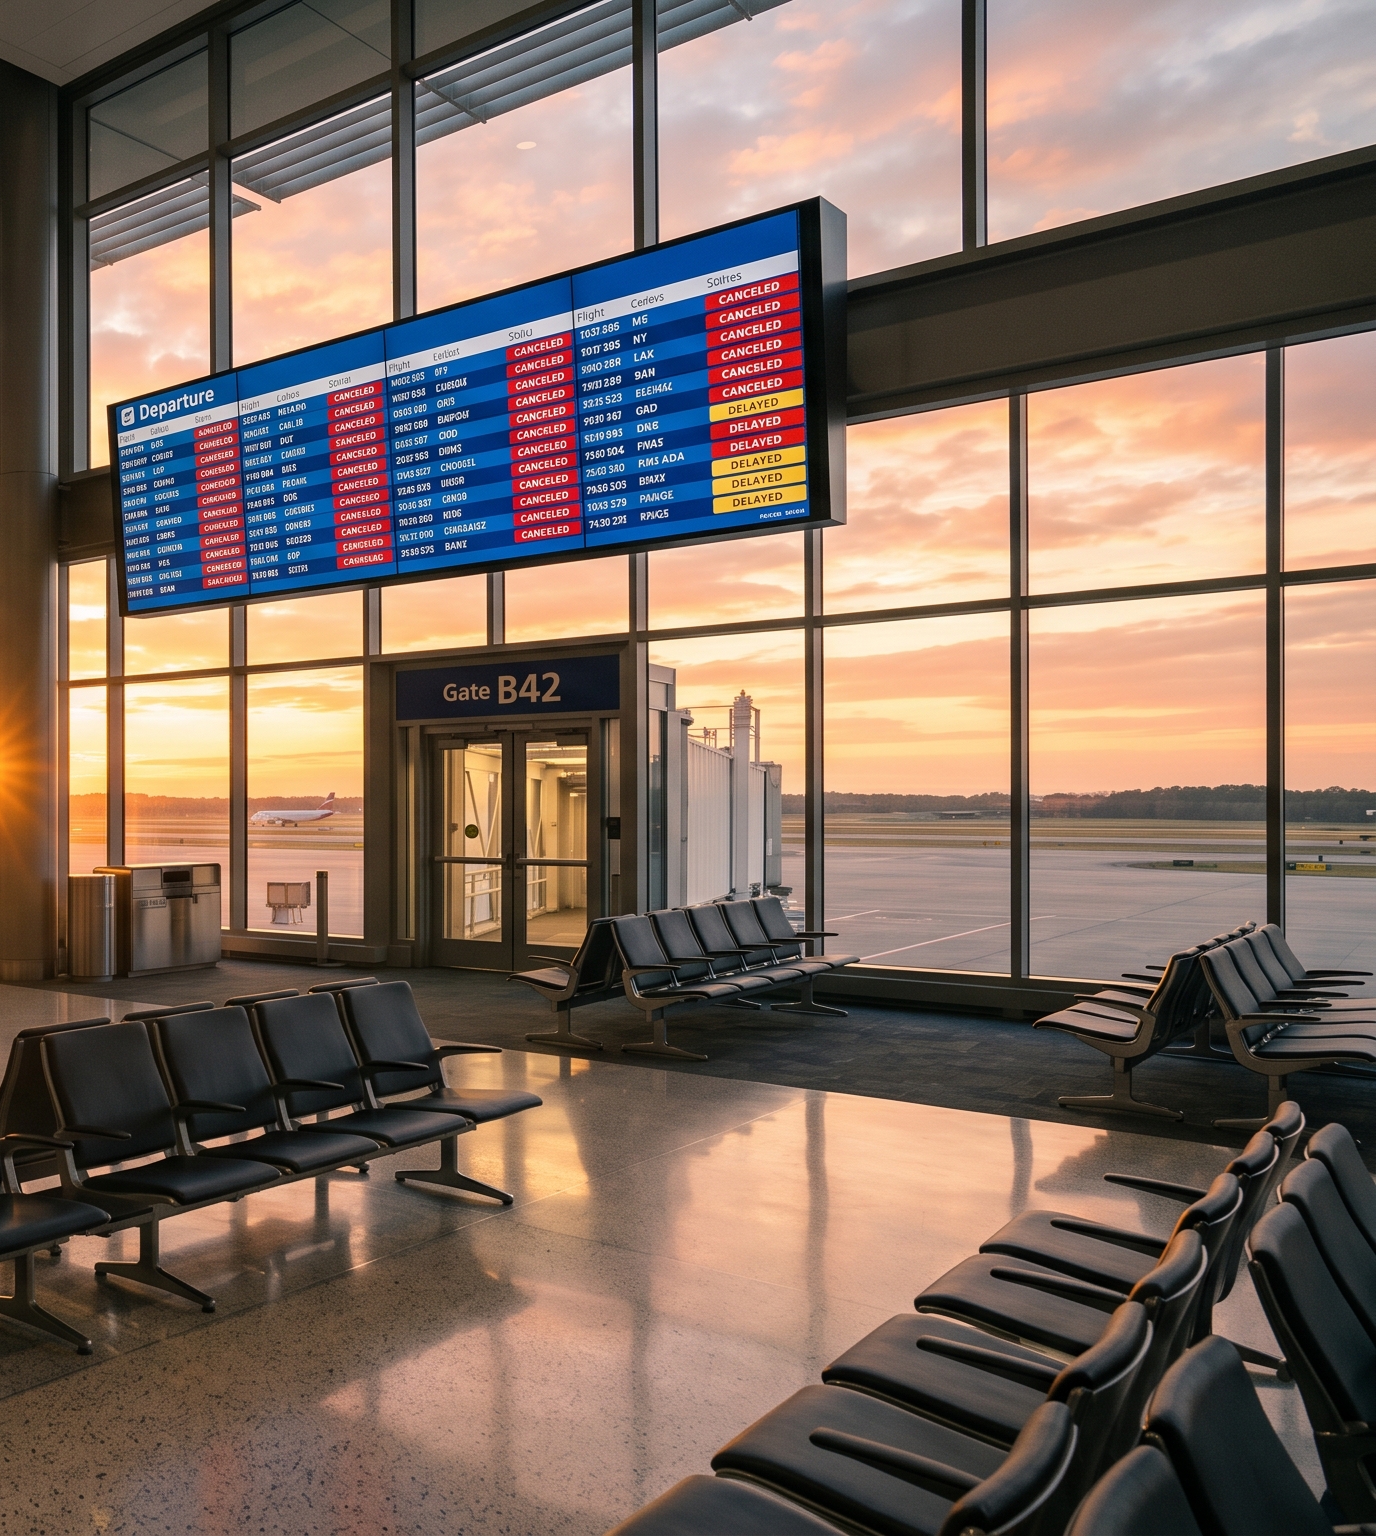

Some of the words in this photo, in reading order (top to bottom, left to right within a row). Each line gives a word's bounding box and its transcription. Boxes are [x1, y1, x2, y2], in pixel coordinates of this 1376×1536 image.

[719, 282, 779, 304] CANCELED
[577, 308, 604, 322] Flight
[633, 332, 647, 344] NY
[719, 301, 780, 323] CANCELED
[720, 320, 781, 341] CANCELED
[514, 338, 563, 356] CANCELED
[721, 340, 782, 360] CANCELED
[516, 372, 564, 390] CANCELED
[723, 378, 782, 397] CANCELED
[334, 386, 374, 401] CANCELED
[516, 389, 565, 407] CANCELED
[140, 389, 214, 420] Departure
[729, 398, 778, 414] DELAYED
[730, 416, 781, 433] DELAYED
[518, 441, 567, 456] CANCELED
[661, 451, 684, 463] ADA
[730, 435, 781, 452] DELAYED
[519, 457, 567, 473] CANCELED
[731, 454, 781, 469] DELAYED
[520, 475, 568, 489] CANCELED
[732, 473, 782, 488] DELAYED
[520, 491, 568, 506] CANCELED
[733, 492, 782, 507] DELAYED
[443, 684, 490, 702] Gate
[498, 672, 561, 705] B42
